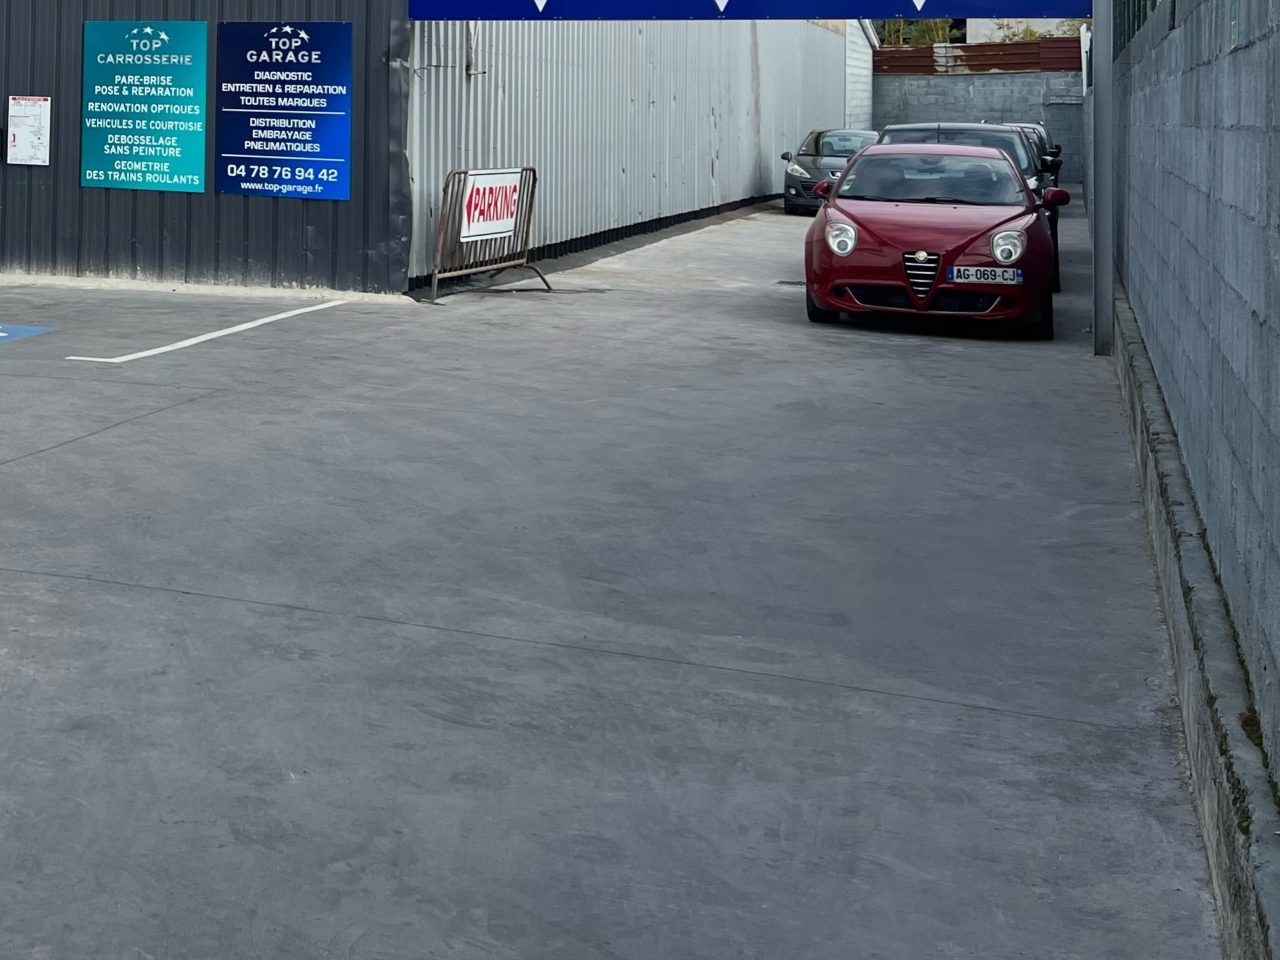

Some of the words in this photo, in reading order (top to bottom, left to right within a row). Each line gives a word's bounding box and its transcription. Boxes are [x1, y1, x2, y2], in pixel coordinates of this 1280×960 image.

[130, 39, 162, 52] TOP
[268, 38, 302, 50] TOP
[96, 53, 193, 65] CARROSSERIE
[246, 50, 322, 63] GARAGE
[114, 75, 173, 86] PARE-BRISE
[254, 71, 313, 81] DIAGNOSTIC
[95, 86, 120, 95] POSE
[122, 87, 128, 95] &
[131, 87, 194, 97] REPARATION
[221, 83, 273, 93] ENTRETIEN
[274, 84, 282, 93] &
[284, 84, 347, 95] REPARATION
[239, 96, 276, 106] TOUTES
[278, 97, 327, 108] MARQUES
[87, 102, 148, 113] RENOVATION
[150, 104, 200, 115] OPTIQUES
[85, 118, 133, 129] VEHICULES
[135, 120, 147, 130] DE
[149, 121, 203, 132] COURTOISIE
[249, 117, 316, 129] DISTRIBUTION
[107, 134, 178, 146] DEBOSSELAGE
[252, 129, 313, 140] EMBRAYAGE
[103, 145, 130, 155] SANS
[132, 146, 182, 157] PEINTURE
[244, 140, 321, 152] PNEUMATIQUES
[114, 160, 170, 172] GEOMETRIE
[86, 170, 105, 180] DES
[107, 171, 143, 182] TRAINS
[146, 173, 200, 185] ROULANTS
[227, 164, 246, 177] 04
[249, 165, 269, 178] 78
[272, 166, 291, 179] 76
[295, 167, 315, 180] 94
[317, 168, 338, 182] 42
[240, 182, 324, 194] www.top-garage.fr
[472, 184, 518, 224] PARKING
[955, 267, 1016, 282] AG-069-CJ
